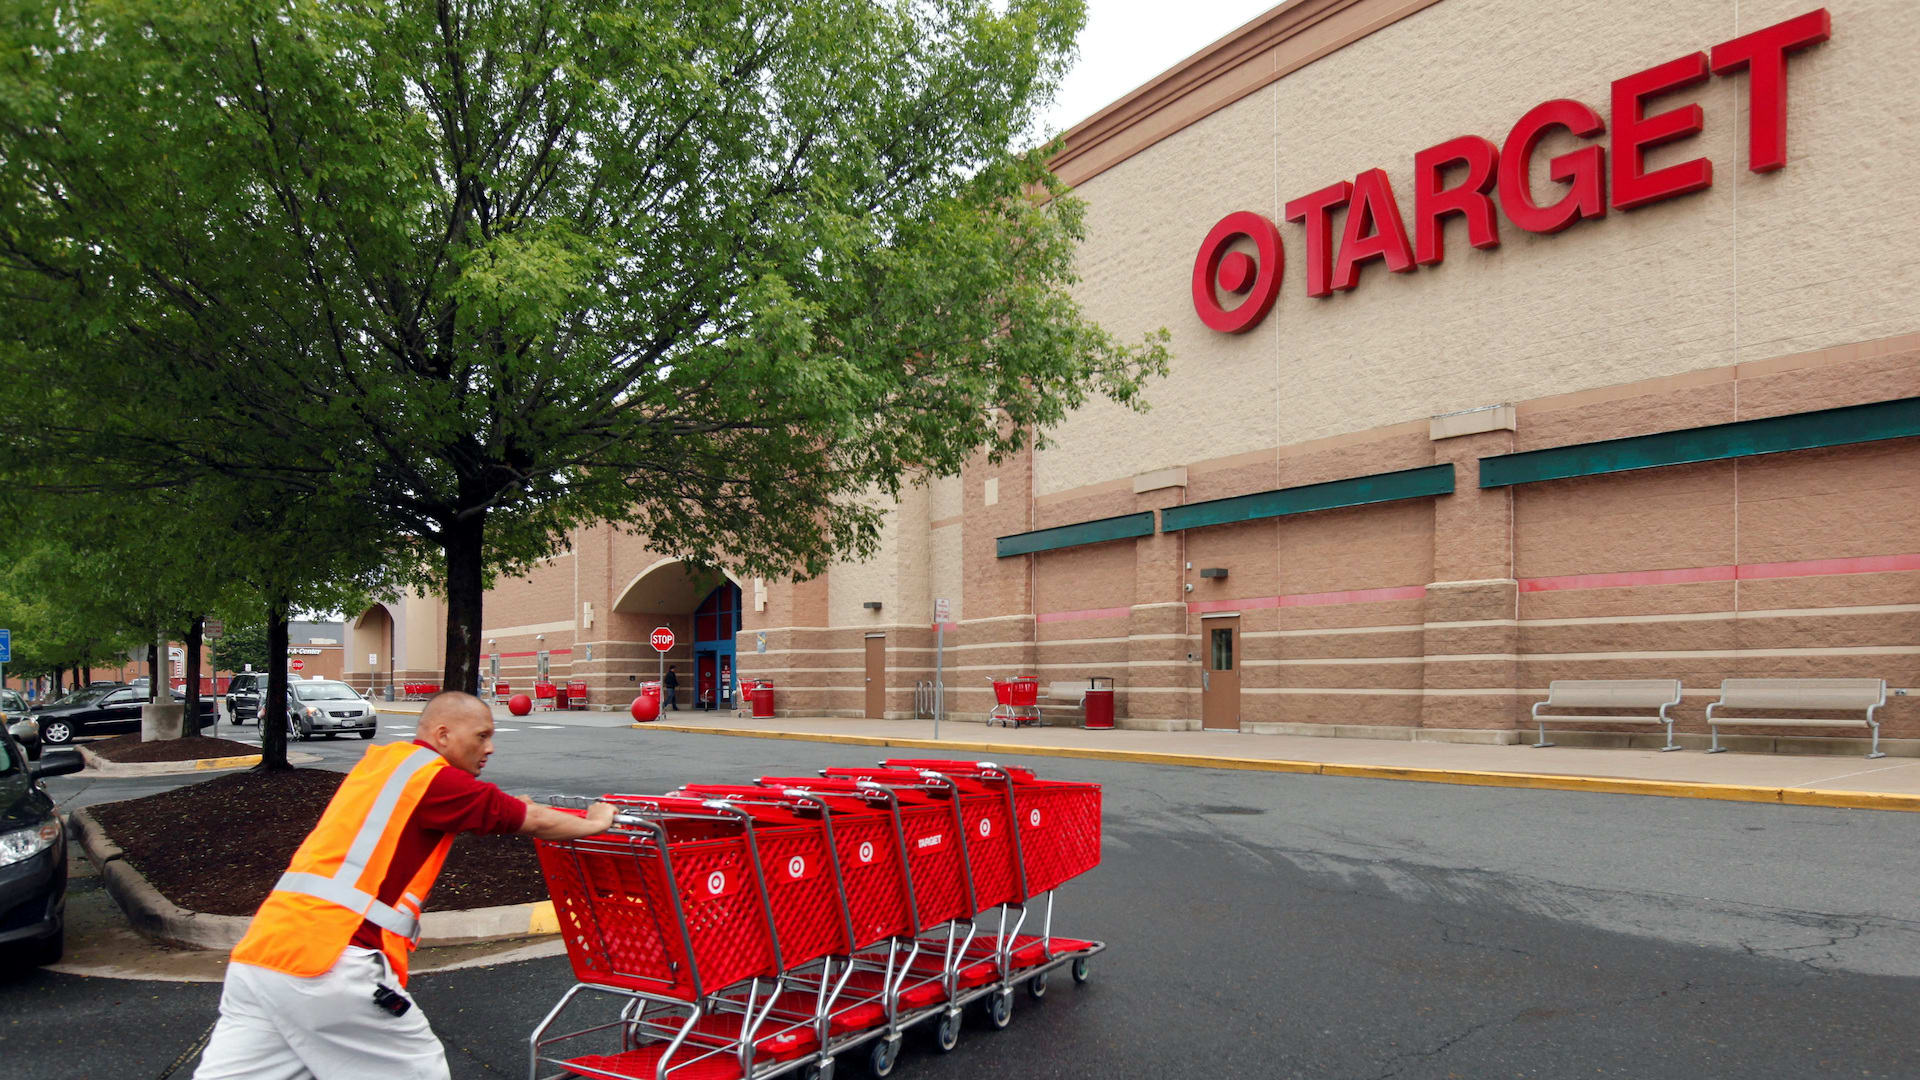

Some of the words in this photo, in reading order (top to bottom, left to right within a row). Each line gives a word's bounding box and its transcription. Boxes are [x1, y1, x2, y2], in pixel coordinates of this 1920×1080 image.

[1285, 7, 1832, 299] TARGET
[652, 634, 673, 645] STOP
[917, 834, 942, 848] TARGET
